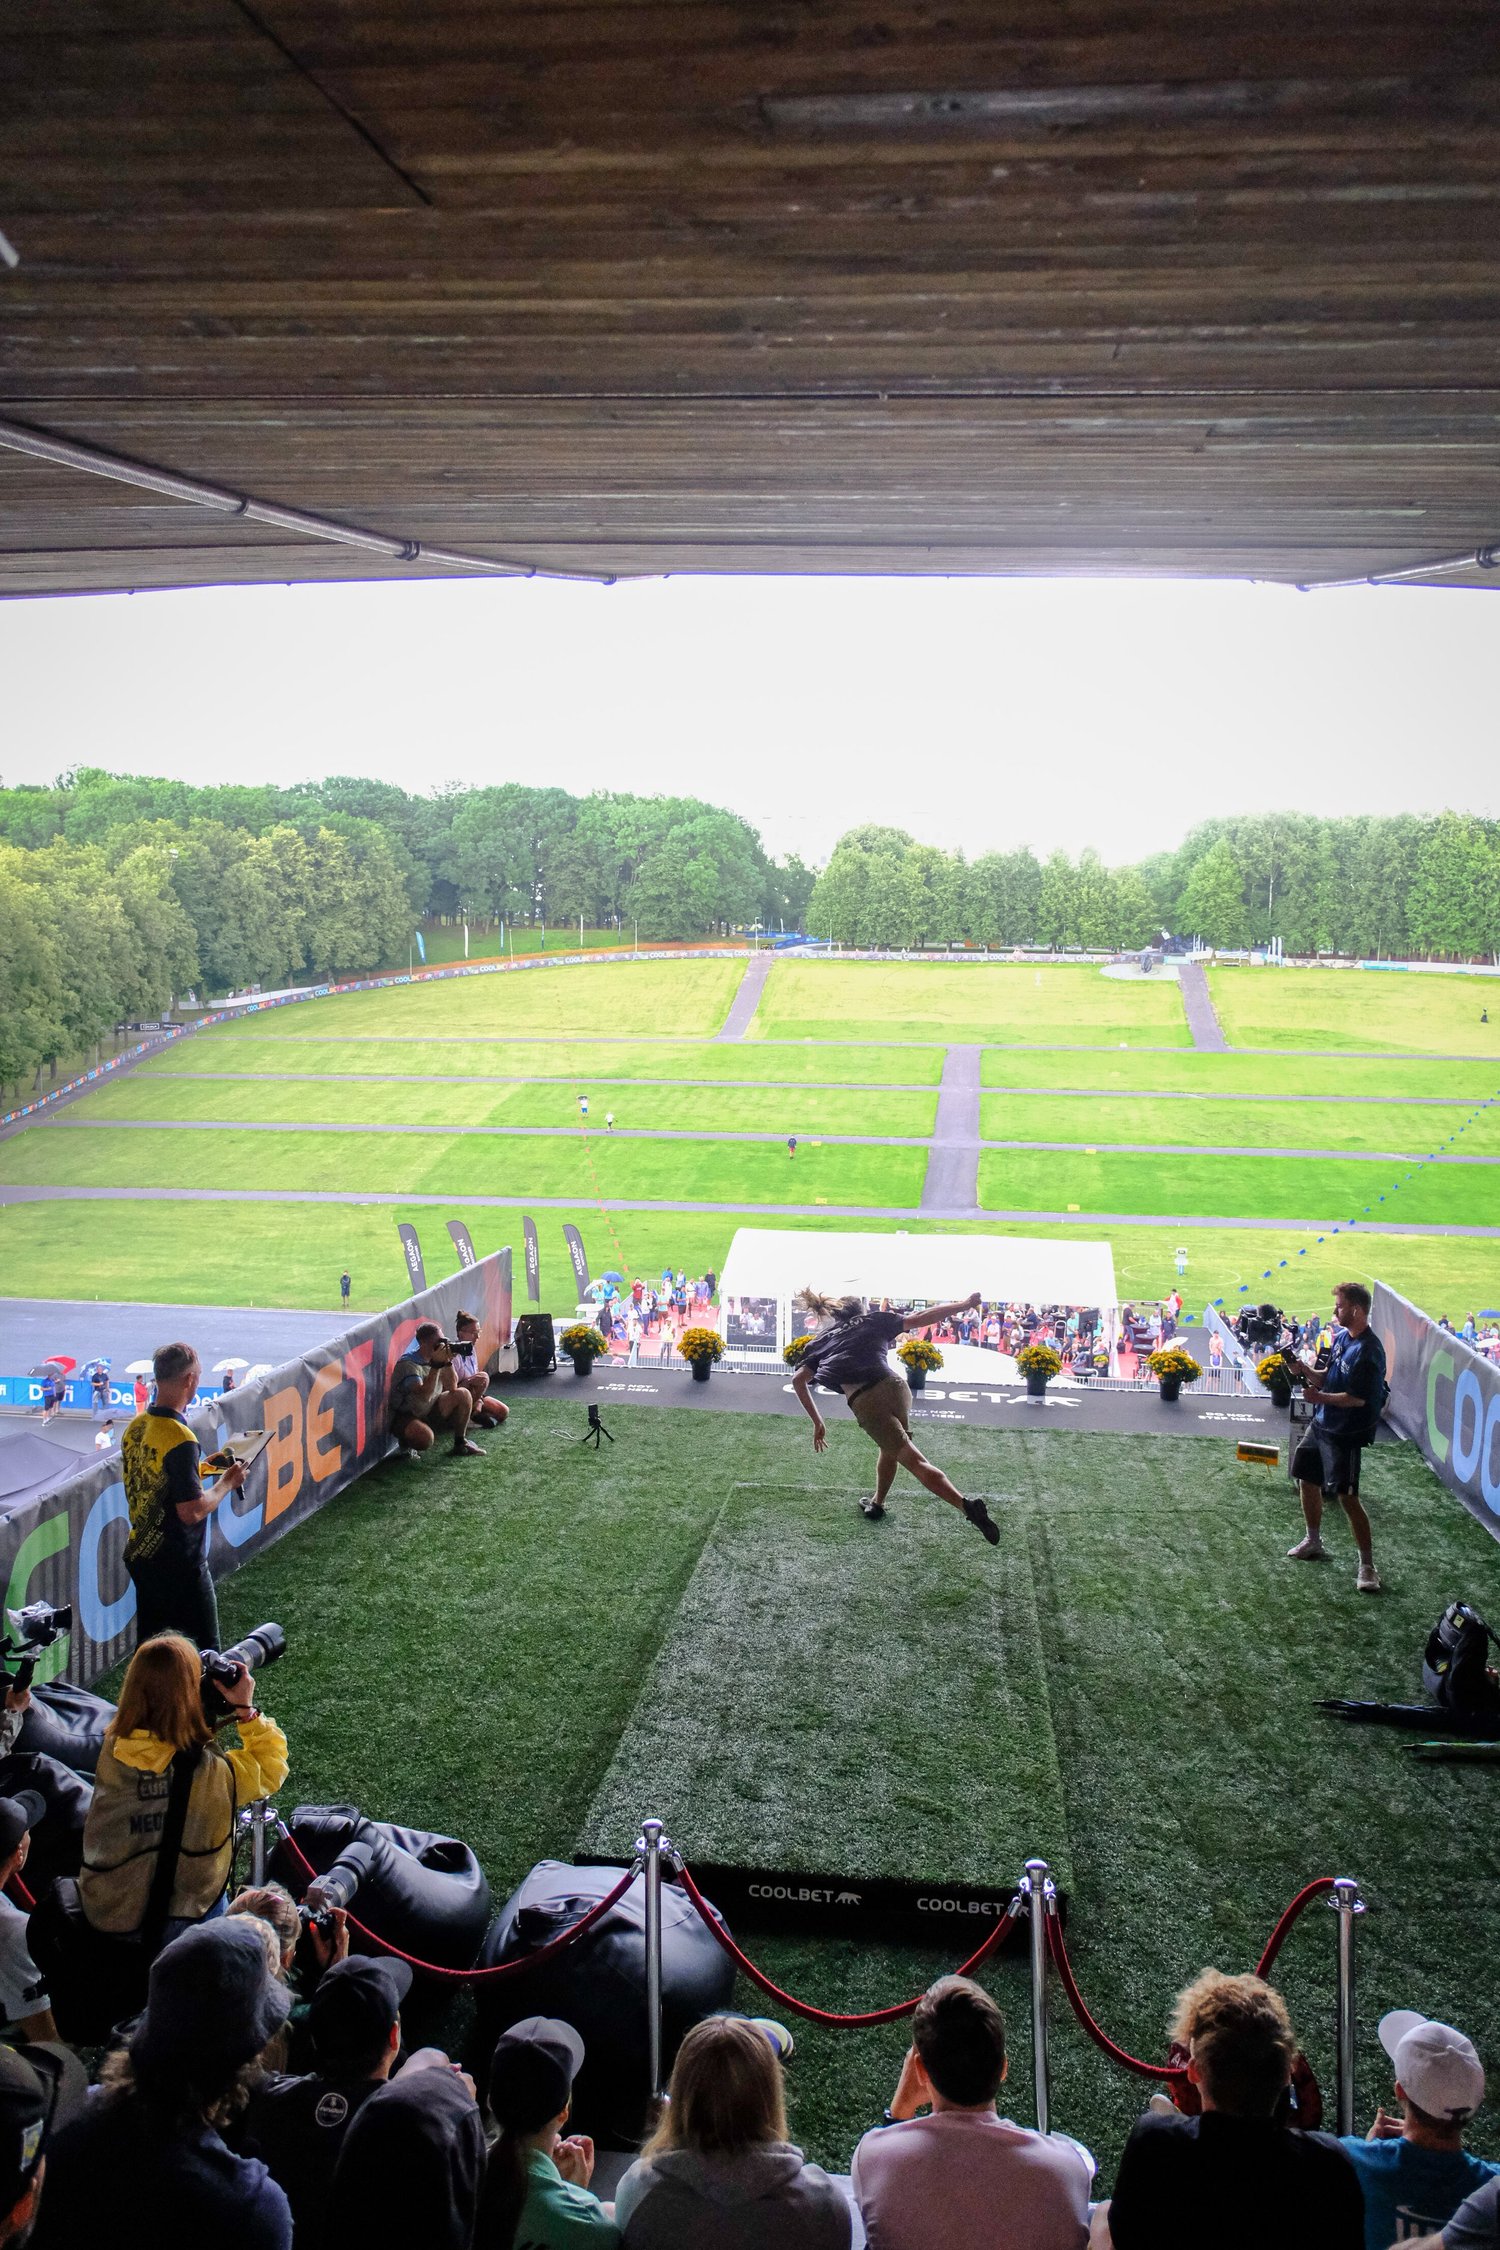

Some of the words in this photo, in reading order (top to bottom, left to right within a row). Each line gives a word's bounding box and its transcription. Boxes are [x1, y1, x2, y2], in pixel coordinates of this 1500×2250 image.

[405, 1239, 419, 1272] AEGAON
[457, 1239, 471, 1266] GAON
[528, 1237, 536, 1275] AEGAON
[569, 1240, 584, 1276] AEGAON
[29, 1384, 73, 1402] Dfi
[783, 1383, 1010, 1404] COBET
[3, 1340, 373, 1687] COLBET
[130, 1811, 165, 1835] MED
[748, 1884, 834, 1903] COOLBET
[917, 1898, 1004, 1916] COOLBET
